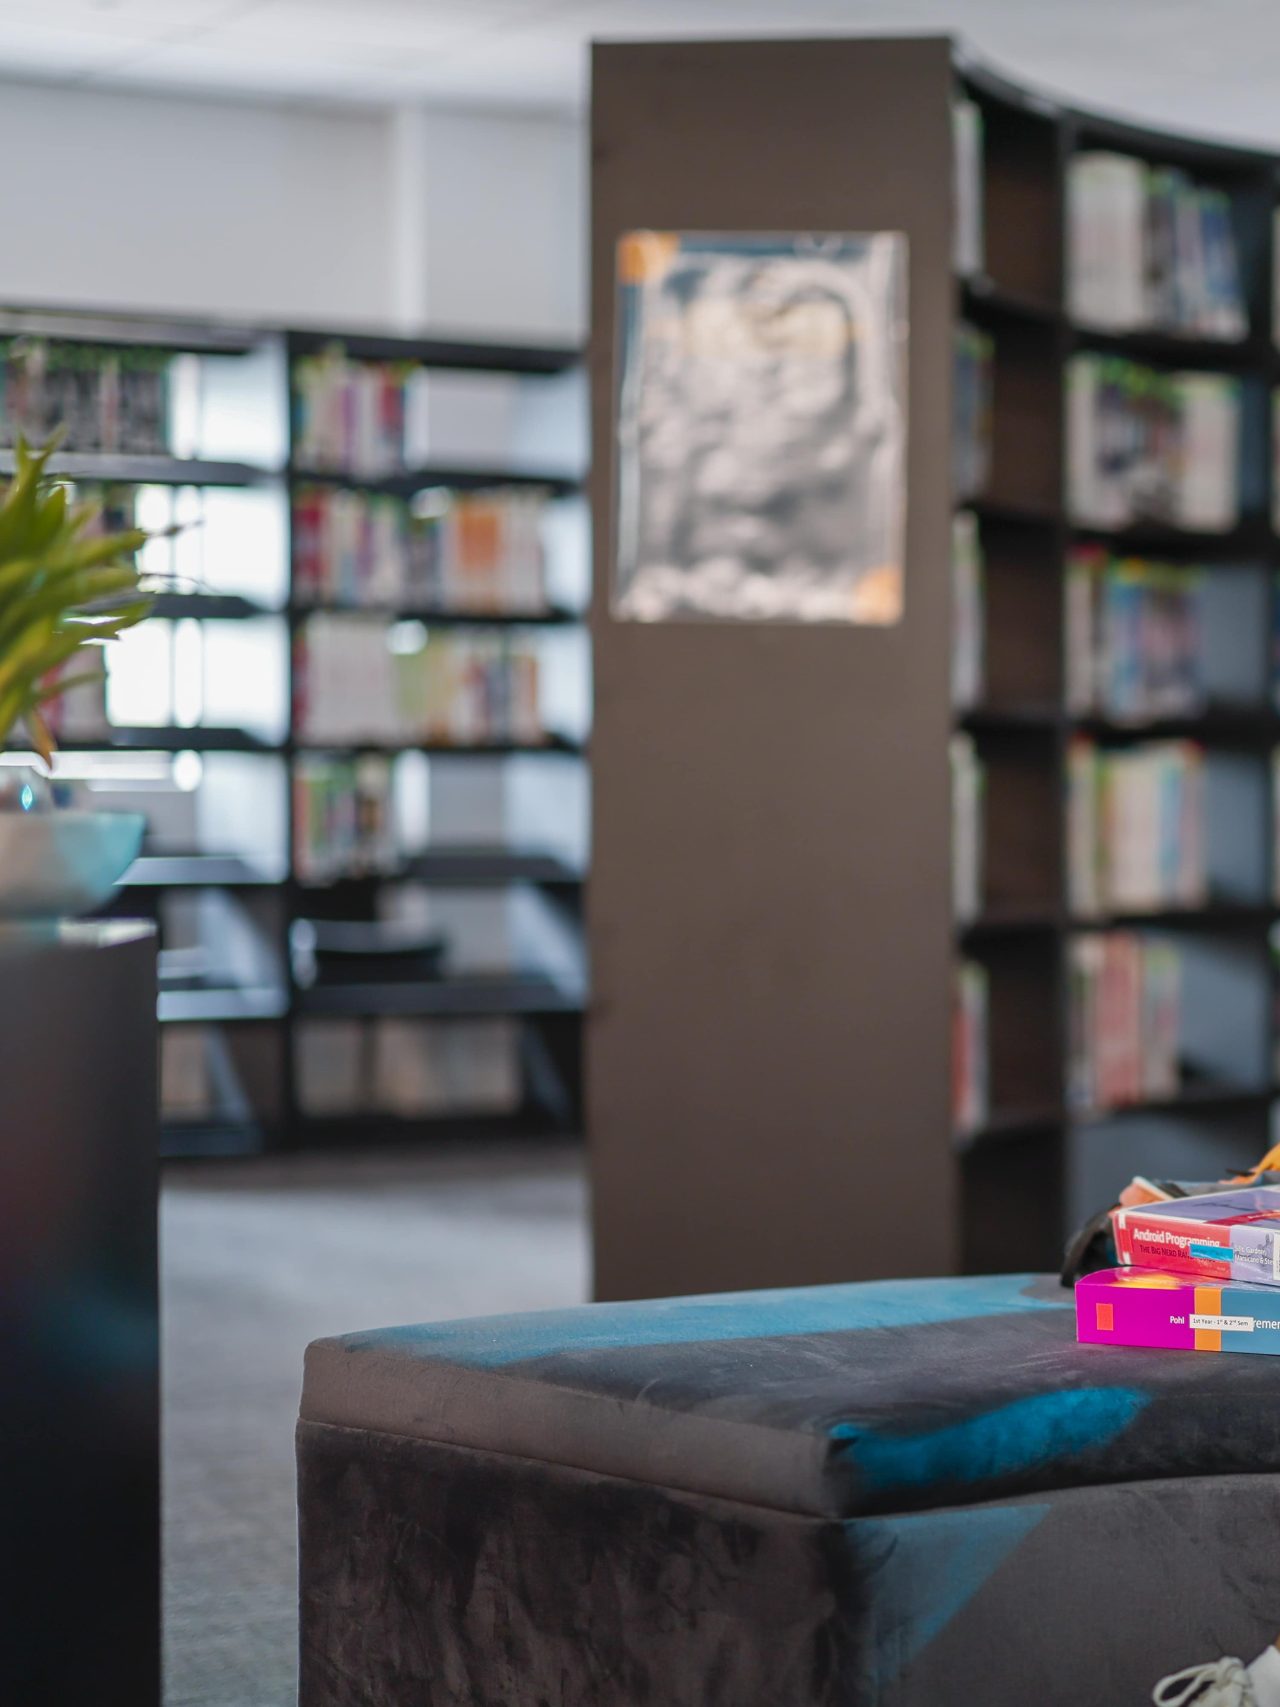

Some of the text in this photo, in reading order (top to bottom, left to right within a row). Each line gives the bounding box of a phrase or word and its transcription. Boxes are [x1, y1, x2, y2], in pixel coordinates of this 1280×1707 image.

[1133, 1227, 1165, 1244] Android
[1165, 1231, 1220, 1249] Programming
[1140, 1244, 1150, 1254] THE
[1162, 1247, 1177, 1257] NERD
[1169, 1315, 1185, 1325] Pohl
